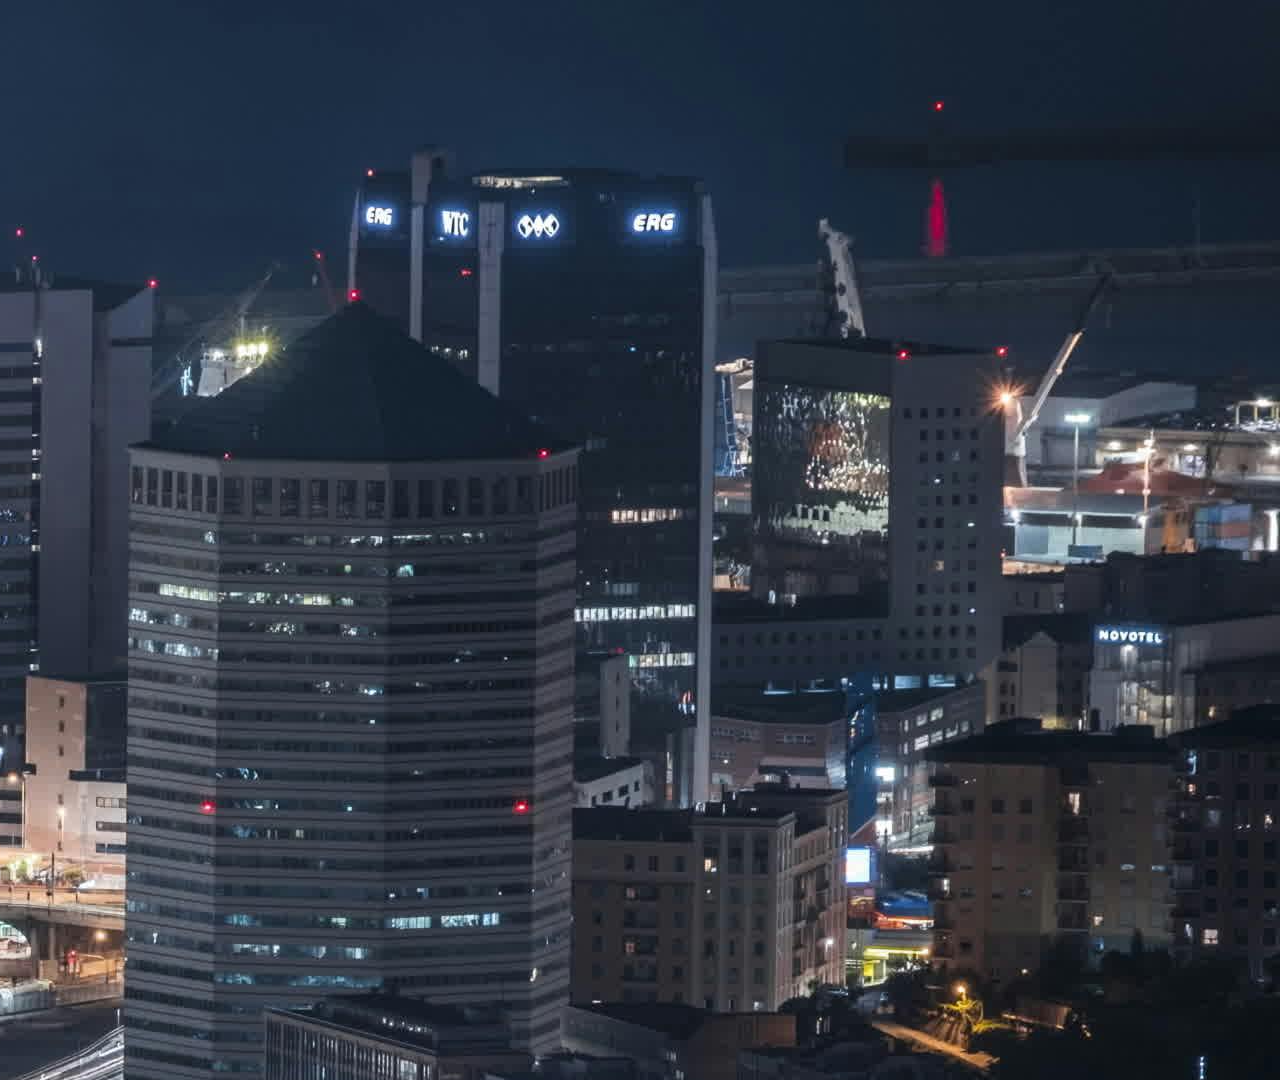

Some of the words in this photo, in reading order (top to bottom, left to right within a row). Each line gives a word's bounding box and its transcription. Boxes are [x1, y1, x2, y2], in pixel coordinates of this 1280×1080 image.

[441, 210, 470, 236] WTC
[633, 213, 676, 232] ERG
[1099, 629, 1162, 643] NOVOTEL
